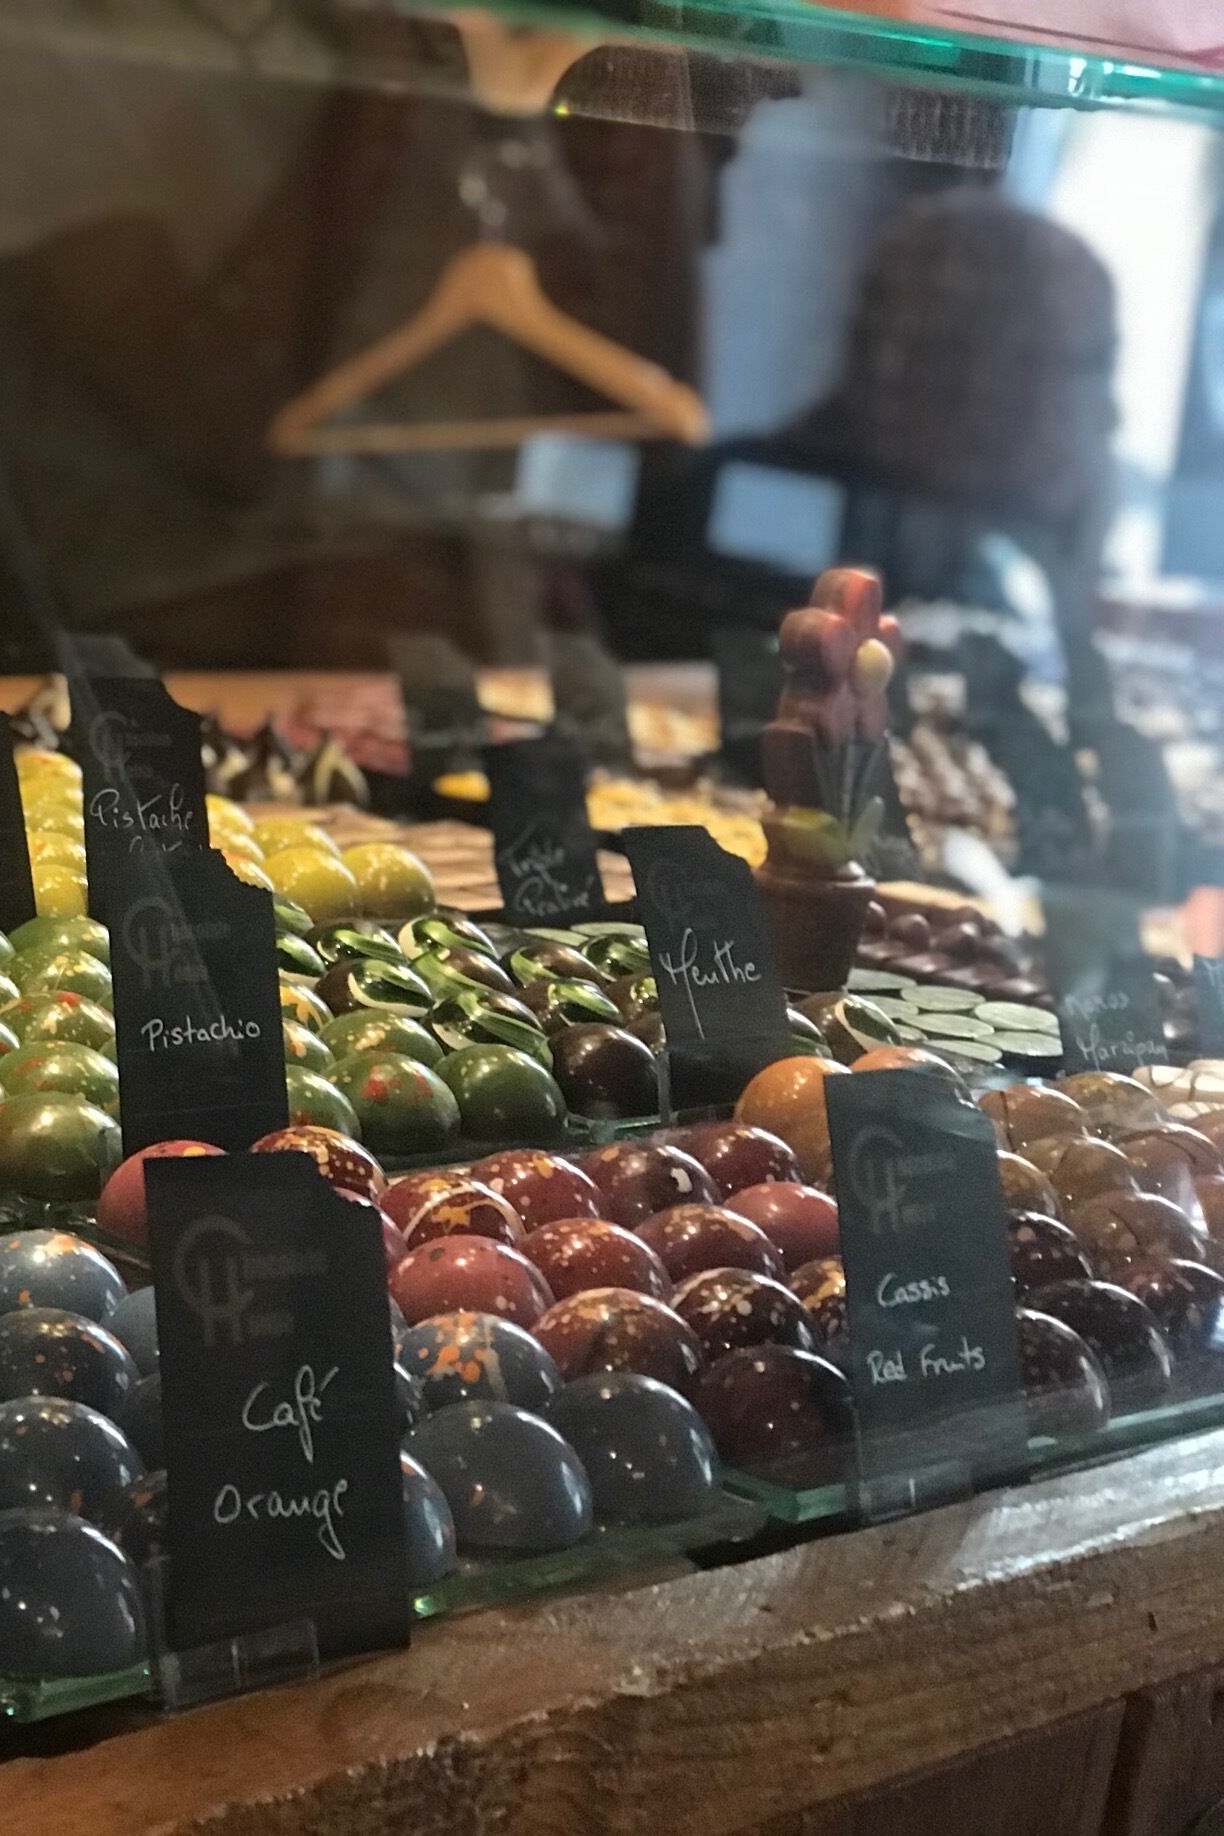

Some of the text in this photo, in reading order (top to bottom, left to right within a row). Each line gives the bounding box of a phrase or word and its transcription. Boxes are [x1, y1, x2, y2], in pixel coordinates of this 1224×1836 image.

[90, 783, 193, 831] Pistache
[658, 926, 762, 1040] Menthe
[141, 1014, 261, 1051] Pistachio
[878, 1272, 951, 1308] Cassis
[866, 1335, 986, 1385] Red Fruits
[241, 1364, 340, 1464] Café
[213, 1477, 348, 1560] Orange
